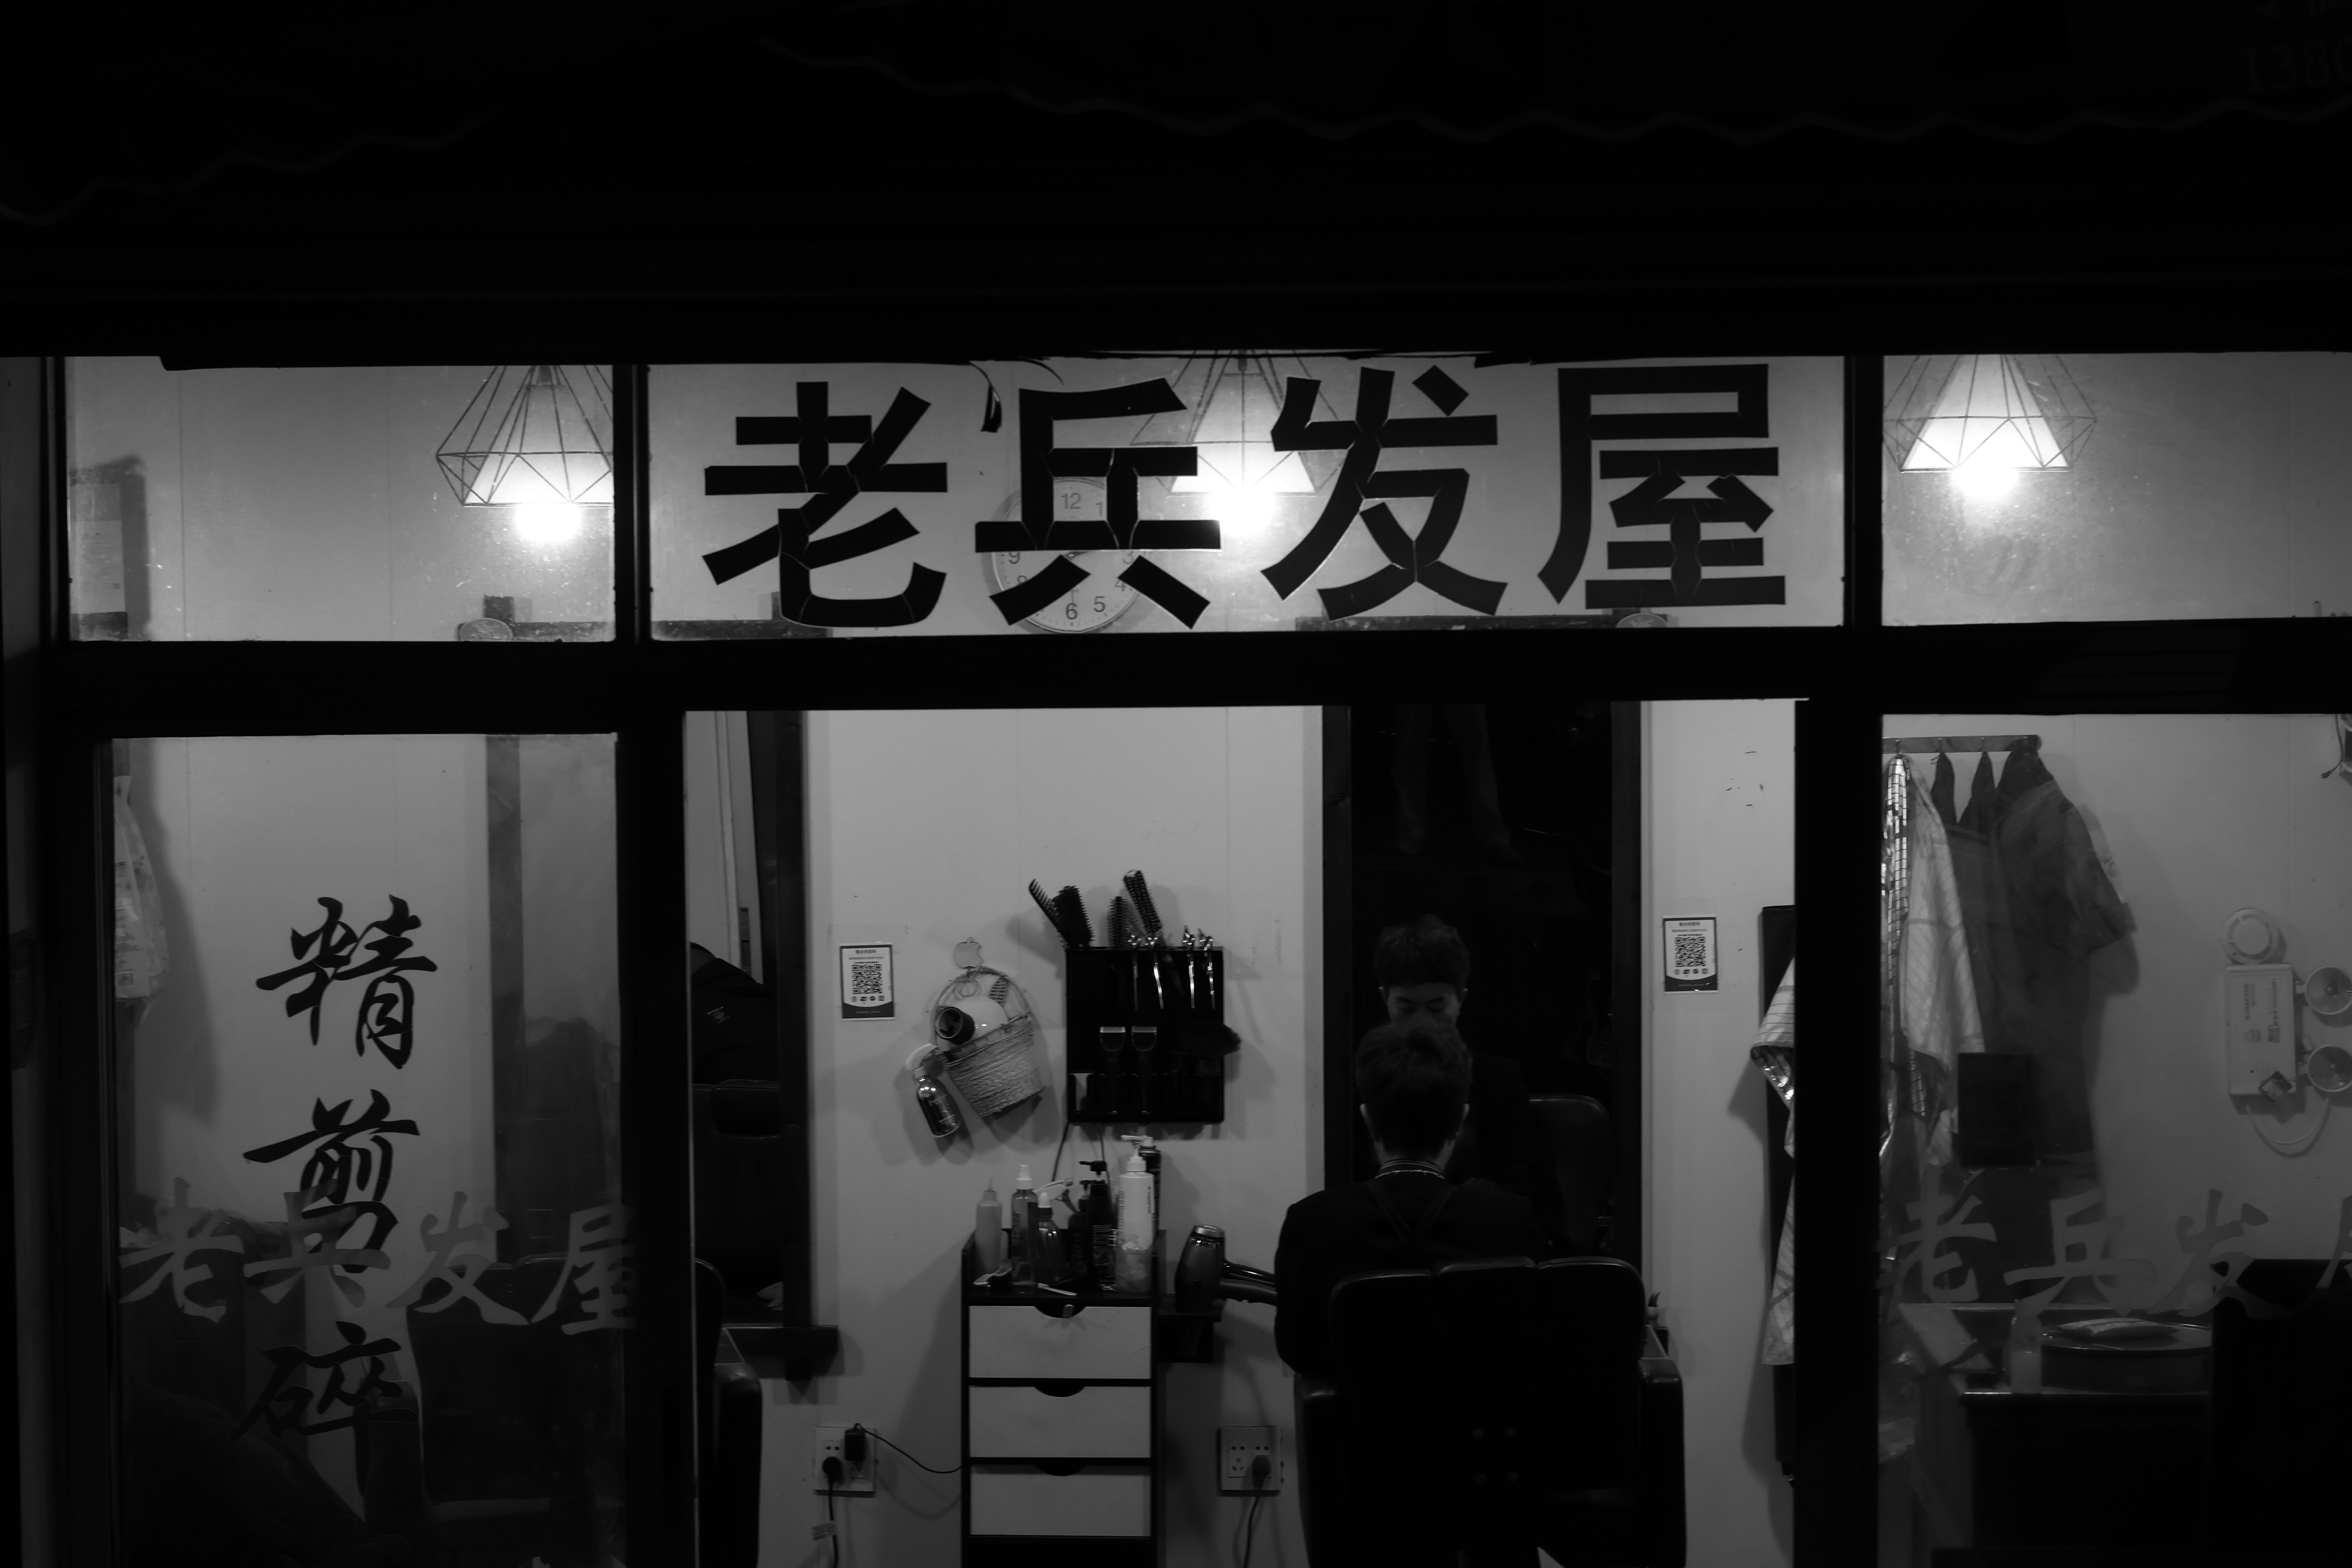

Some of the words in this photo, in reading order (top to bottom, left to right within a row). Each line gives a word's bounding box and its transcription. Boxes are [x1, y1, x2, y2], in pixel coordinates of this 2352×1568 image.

[703, 365, 1786, 630] 老兵发屋
[1060, 492, 1081, 509] 12
[1095, 500, 1103, 517] 1
[1066, 603, 1078, 619] 6
[1094, 596, 1106, 612] 5
